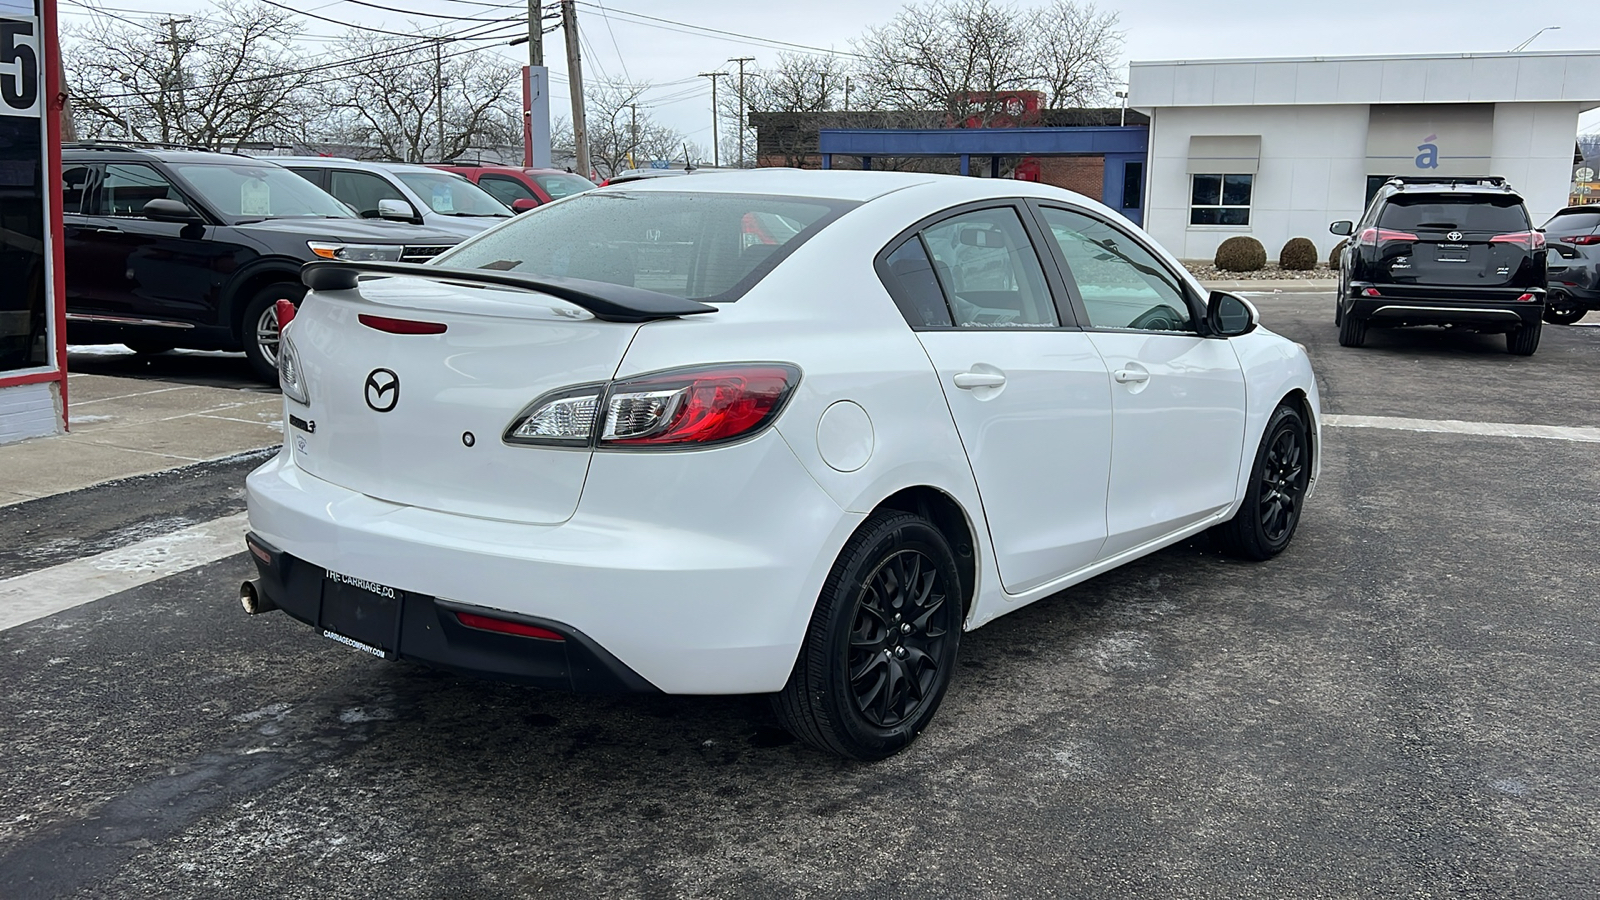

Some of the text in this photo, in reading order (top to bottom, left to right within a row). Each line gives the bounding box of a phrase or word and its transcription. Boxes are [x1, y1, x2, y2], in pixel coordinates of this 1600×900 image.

[0, 21, 37, 110] 5
[341, 574, 382, 595] CARRIAGE
[381, 586, 396, 600] CO.
[323, 629, 386, 659] CARRIAGECOMPANY.COM
